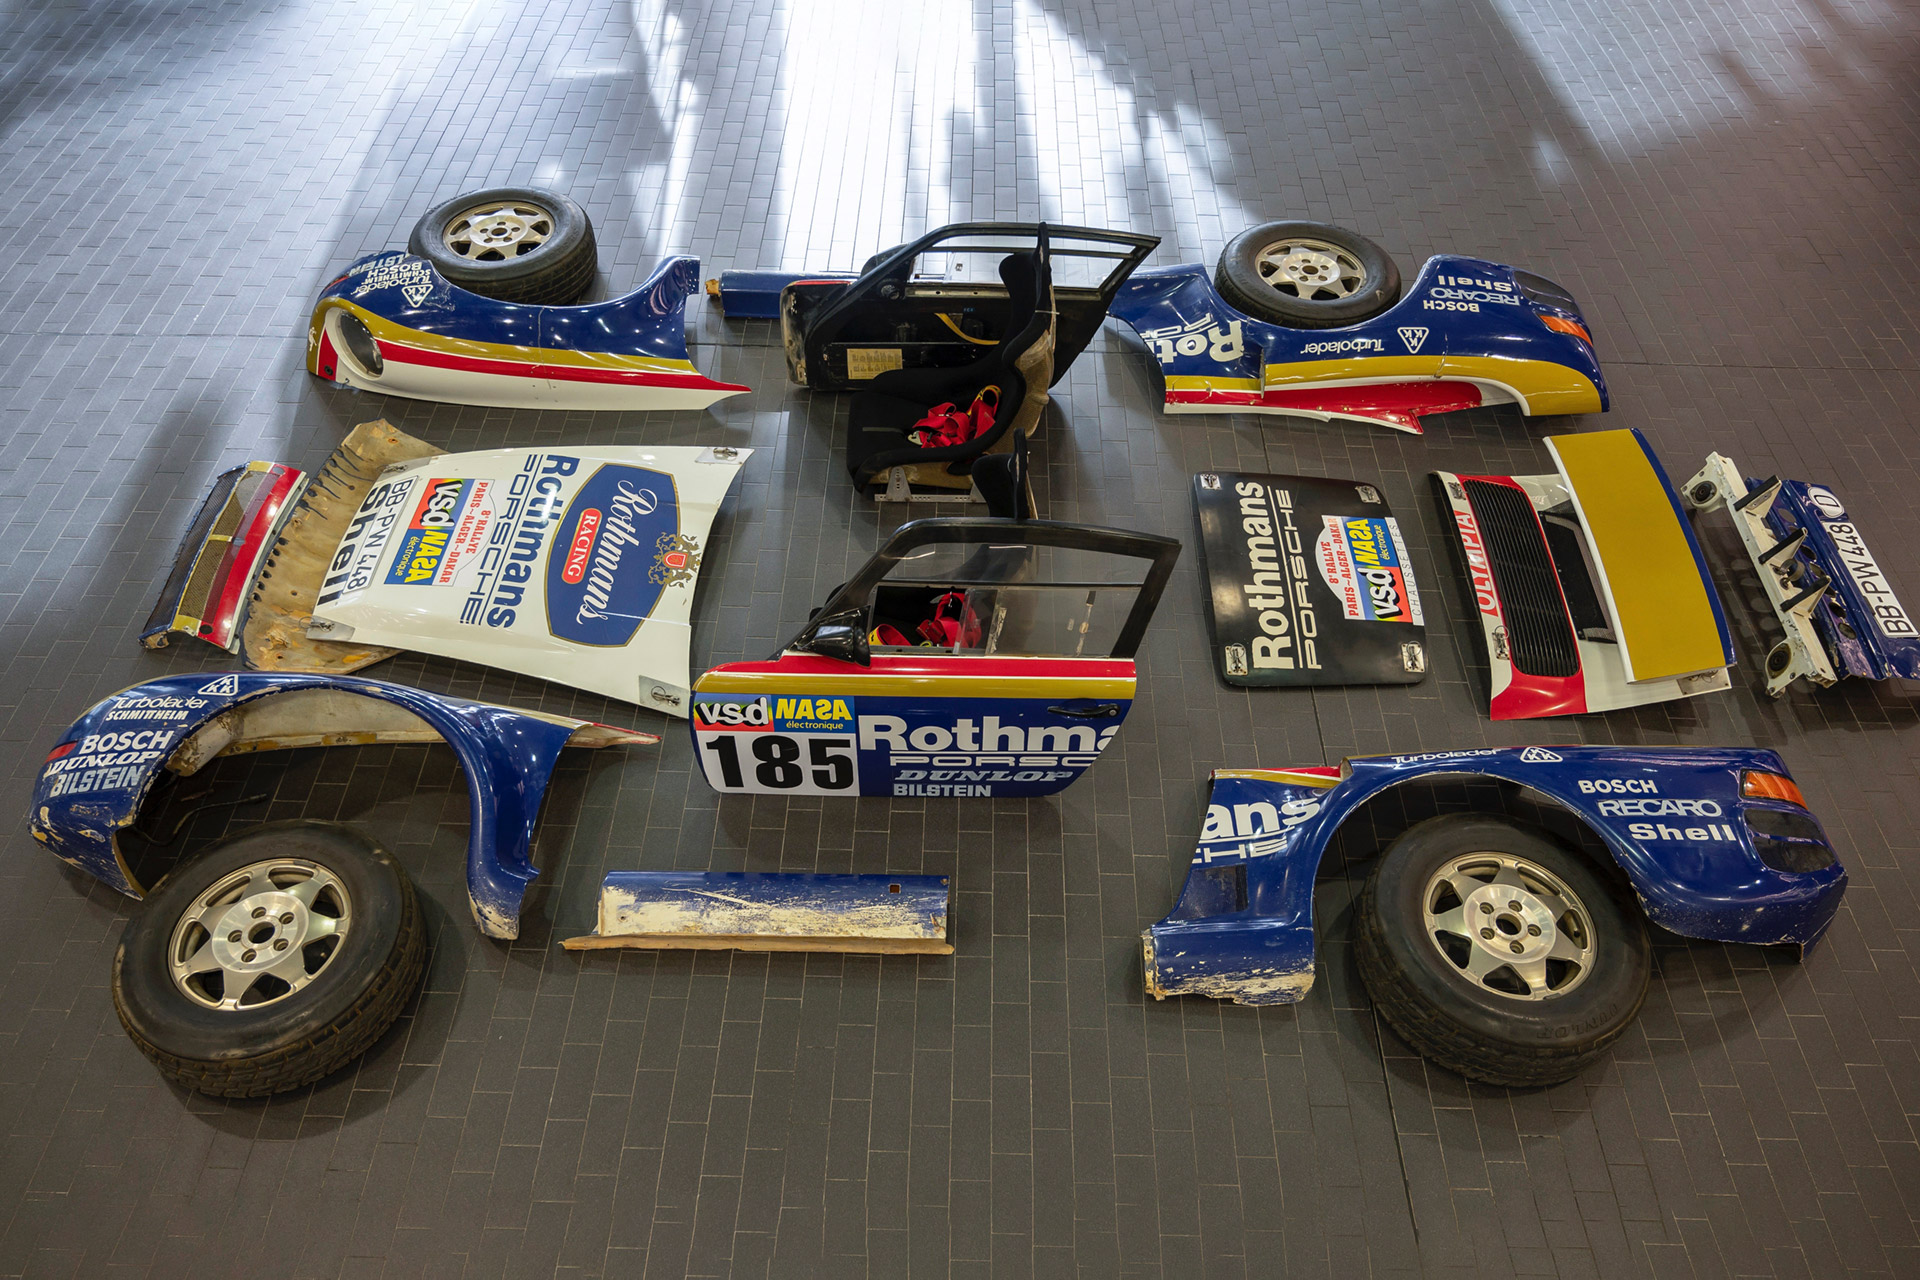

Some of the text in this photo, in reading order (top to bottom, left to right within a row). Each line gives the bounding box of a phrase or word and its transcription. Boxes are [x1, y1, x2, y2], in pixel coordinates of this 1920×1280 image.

[350, 275, 432, 295] Turbolader
[367, 262, 422, 278] BOSCH
[1438, 275, 1512, 292] Shell
[1423, 300, 1480, 313] BOSCH
[1430, 287, 1520, 306] RECARO
[1147, 320, 1245, 363] Rot
[1300, 338, 1385, 355] Turbolader
[420, 480, 463, 527] vsd
[317, 483, 392, 606] Shell
[459, 454, 538, 625] PORSCHE
[465, 520, 489, 554] RALLYE
[486, 454, 581, 628] Rothmans
[567, 513, 598, 578] RACING
[576, 480, 658, 625] Rothmans
[1346, 519, 1380, 566] NASA
[1374, 524, 1391, 560] électronique
[395, 536, 420, 576] électronique
[404, 530, 449, 583] NASA
[1320, 541, 1338, 574] RALLYE
[1389, 524, 1422, 616] CHAUSSETTES
[1456, 513, 1496, 612] OLYMPIA
[1234, 481, 1295, 670] Rothmans
[1275, 489, 1322, 670] PORSCHE
[1357, 567, 1402, 617] vsd
[106, 710, 189, 721] SCHMITTHELM
[112, 695, 209, 710] Turbolader
[697, 696, 769, 726] vsd
[775, 698, 853, 721] NASA
[786, 720, 844, 730] électronique
[79, 730, 175, 754] BOSCH
[1391, 749, 1500, 764] Turbolader
[46, 751, 162, 777] DUNLOP
[705, 734, 854, 790] 185
[895, 770, 1074, 782] DUNLOP
[50, 764, 147, 798] BILSTEIN
[893, 784, 992, 797] BILSTEIN
[1577, 779, 1659, 794] BOSCH
[1598, 800, 1722, 817] RECARO
[1628, 823, 1737, 841] Shell
[1191, 836, 1288, 864] HE
